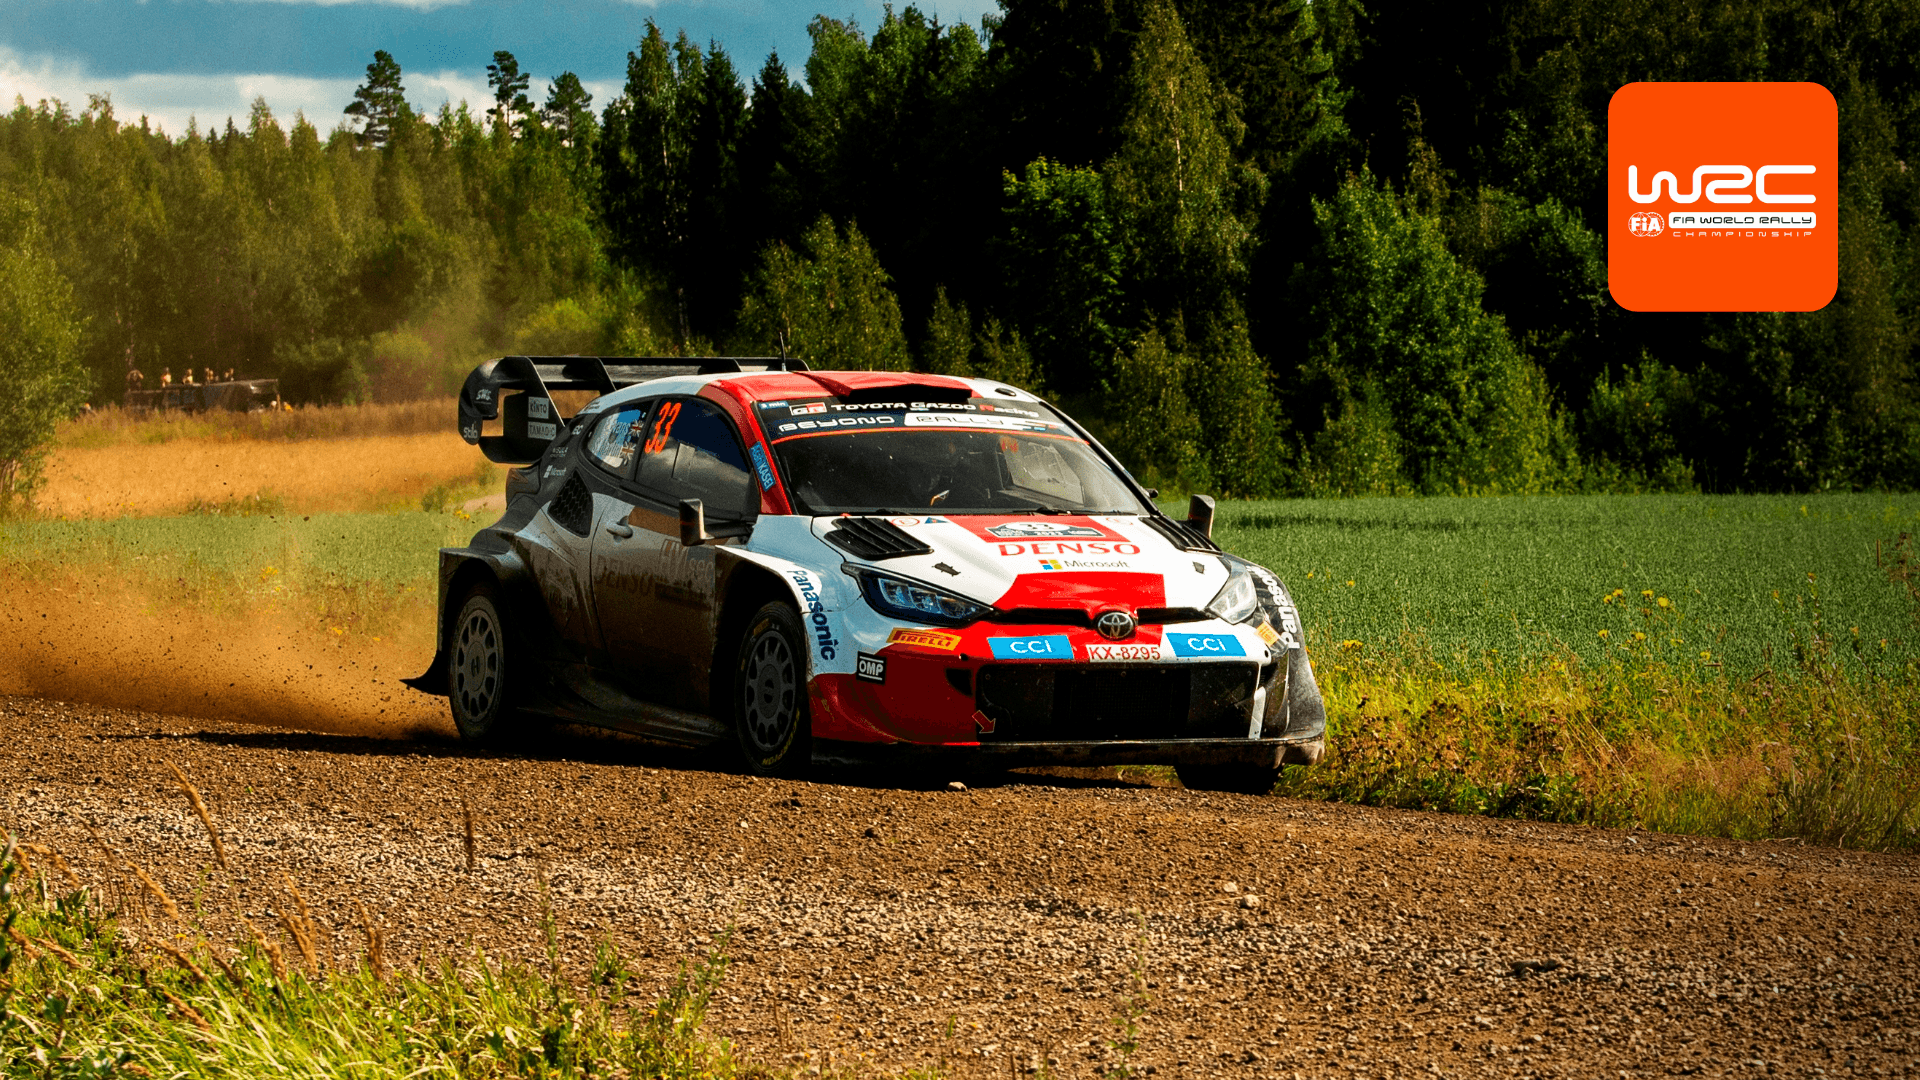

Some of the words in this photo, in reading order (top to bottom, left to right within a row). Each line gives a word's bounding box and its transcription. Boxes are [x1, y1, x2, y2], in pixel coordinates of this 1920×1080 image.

[831, 402, 907, 411] TOYOTA
[911, 402, 976, 411] GAZOO
[979, 404, 1039, 418] Racing
[644, 401, 682, 454] 33
[778, 415, 896, 433] BEYOND
[916, 415, 1004, 426] RALLY
[998, 542, 1142, 556] DENSO
[1064, 559, 1130, 568] Microsoft
[787, 569, 840, 661] Panasonic
[892, 630, 957, 647] PIRELLI
[1010, 639, 1052, 653] CCI
[1188, 637, 1226, 651] CCI
[1089, 646, 1160, 660] KX-8295
[859, 660, 884, 676] OMP
